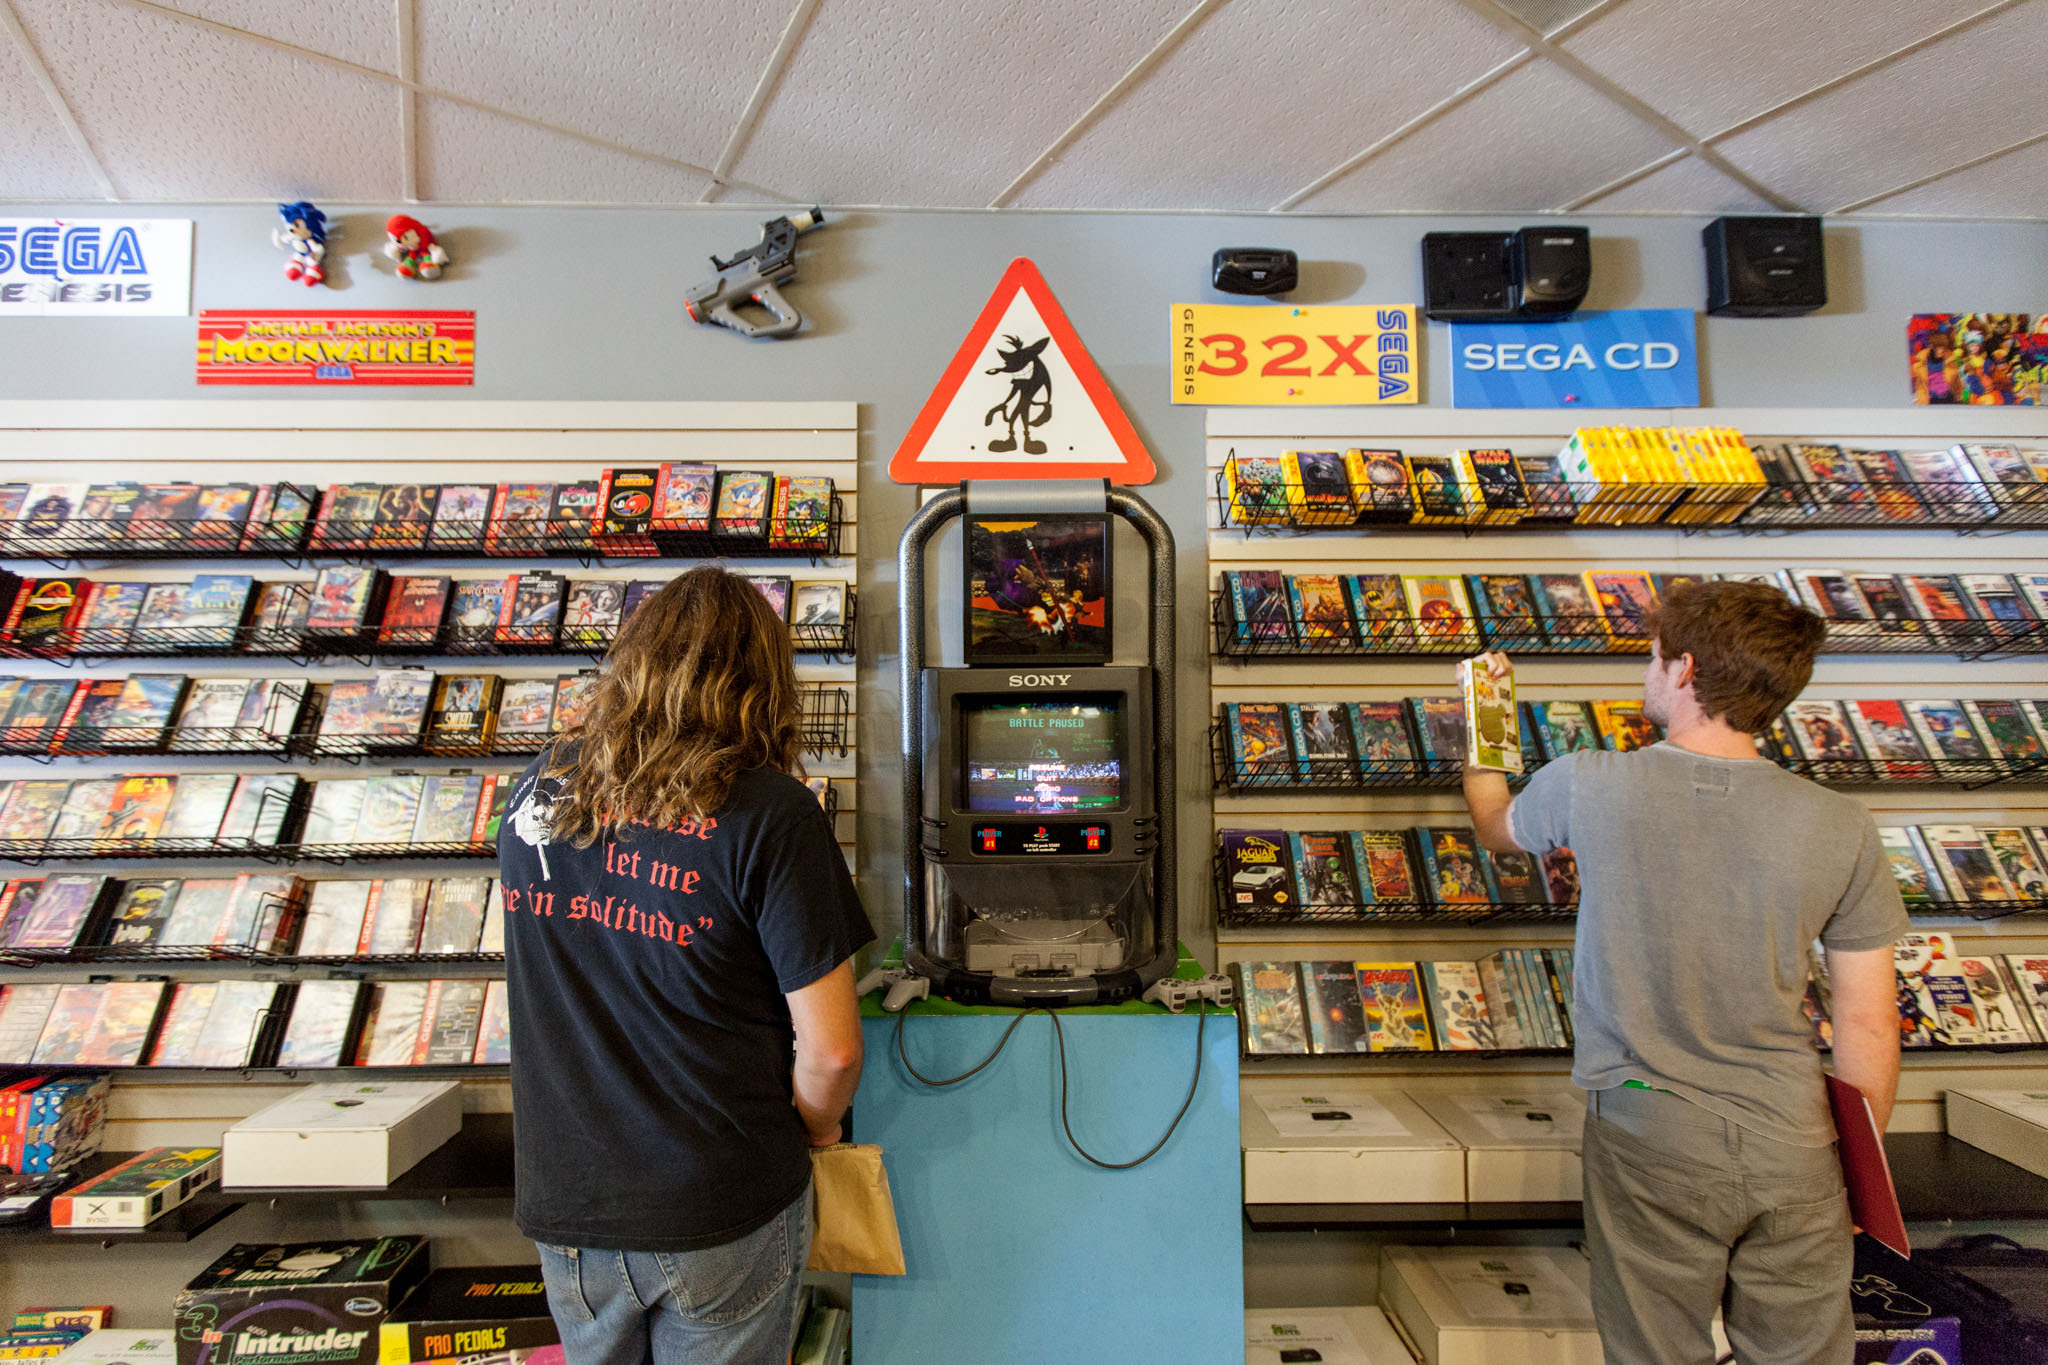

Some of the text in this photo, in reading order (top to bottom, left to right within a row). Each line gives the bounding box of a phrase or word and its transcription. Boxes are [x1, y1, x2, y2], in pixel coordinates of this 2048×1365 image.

[246, 322, 436, 338] MICHAEL JACKSON'S
[213, 334, 460, 365] MOONWALKER
[1183, 308, 1195, 396] GENESIS
[1376, 309, 1410, 401] SEGA
[1463, 342, 1681, 371] SEGA CD
[316, 366, 354, 380] SEGA
[655, 469, 668, 512] GENESIS
[500, 580, 516, 625] GENESIS
[1231, 577, 1246, 621] SEGA CD
[1008, 674, 1072, 687] SONY
[1008, 718, 1085, 729] BATTLE PAUSED
[1291, 709, 1307, 757] SEGA CD
[1415, 704, 1434, 752] SEGA CD
[1033, 785, 1062, 793] AUDIO
[1036, 774, 1059, 782] QUIT
[475, 784, 494, 835] GENESIS
[1015, 795, 1080, 803] PAD OPTIONS
[977, 830, 1003, 838] PLAYER
[985, 840, 995, 848] #1
[1080, 829, 1106, 837] PLAYER
[1088, 838, 1099, 847] #2
[1236, 847, 1276, 859] JAGUAR
[604, 842, 701, 895] let me
[1295, 860, 1303, 875] CD
[528, 883, 555, 918] in
[360, 890, 379, 944] GENESIS
[1928, 936, 1948, 961] 2
[421, 986, 441, 1043] GENESIS
[232, 1267, 331, 1282] Intruder
[464, 1281, 545, 1297] PRO PEDALS
[180, 1303, 219, 1341] 3
[201, 1327, 223, 1344] in
[1885, 1329, 1936, 1341] SATURN
[234, 1326, 369, 1357] Intruder
[423, 1327, 507, 1358] PRO PEDALS
[231, 1347, 361, 1365] Performance Wheel
